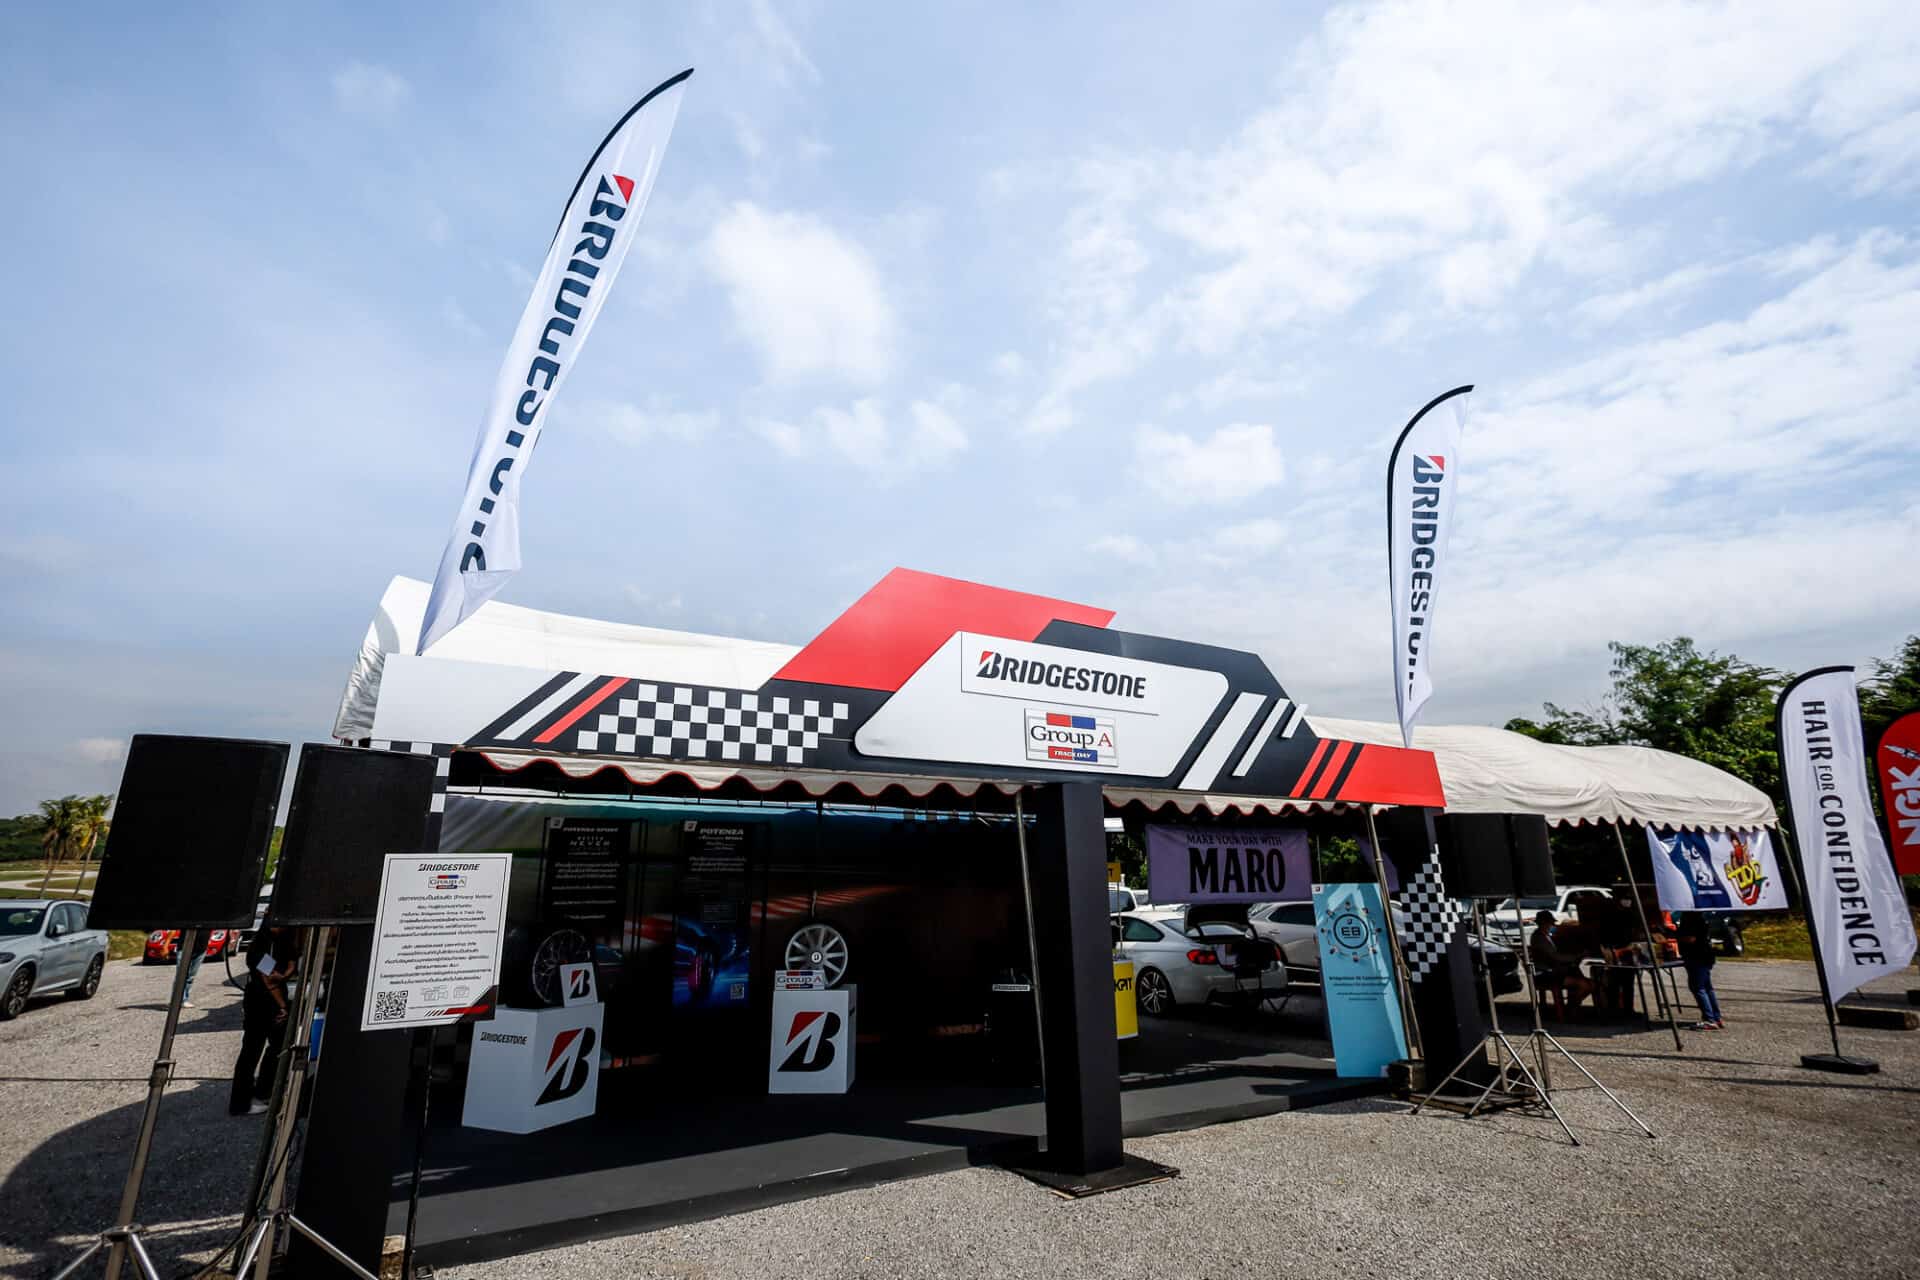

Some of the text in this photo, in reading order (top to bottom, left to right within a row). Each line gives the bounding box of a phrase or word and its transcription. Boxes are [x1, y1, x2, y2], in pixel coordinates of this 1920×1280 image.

[976, 650, 1146, 699] BRIDGESTONE
[1030, 725, 1113, 748] Group A
[1801, 700, 1834, 761] HAIR
[1819, 765, 1835, 791] FOR
[1888, 765, 1920, 845] NGK
[418, 863, 480, 871] BRIDGESTONE
[1188, 848, 1286, 893] MARO
[1819, 795, 1888, 967] CONFIDENCE
[777, 976, 812, 985] Group
[480, 1032, 528, 1045] BRIDGESTONE
